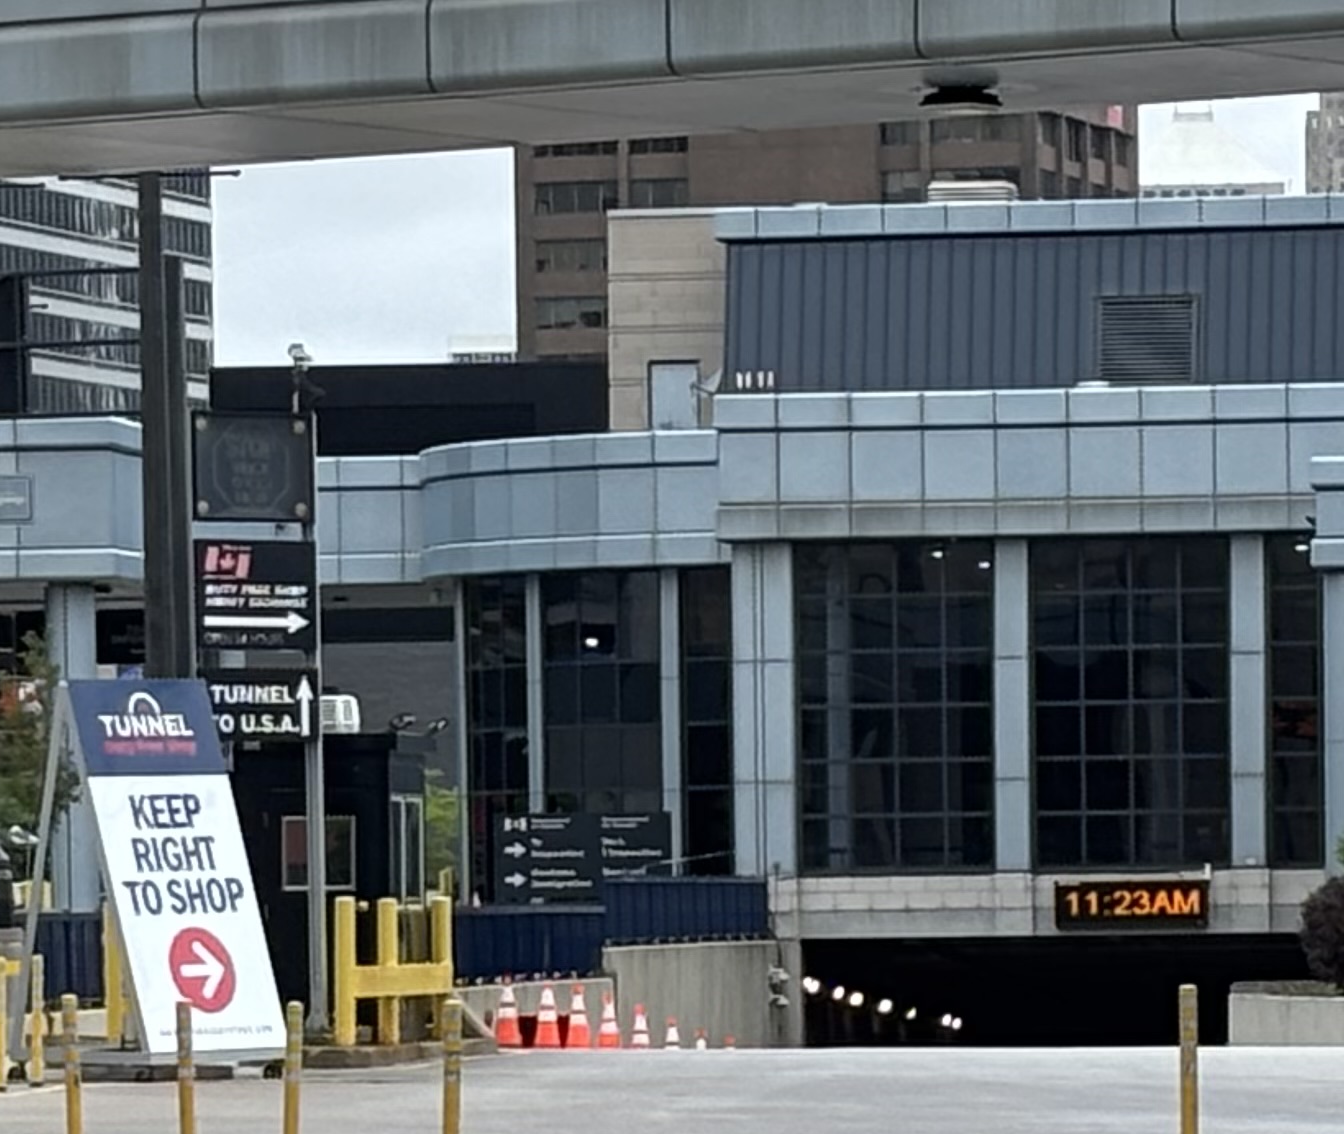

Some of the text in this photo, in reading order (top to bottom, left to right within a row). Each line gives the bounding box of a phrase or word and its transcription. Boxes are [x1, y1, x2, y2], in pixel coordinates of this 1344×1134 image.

[209, 684, 295, 704] TUNNEL
[97, 714, 194, 737] TUNNEL
[240, 714, 301, 734] U.S.A.
[128, 793, 201, 830] KEEP
[131, 836, 216, 873] RIGHT
[121, 878, 244, 916] TO SHOP
[1066, 889, 1200, 916] 11:23AM
